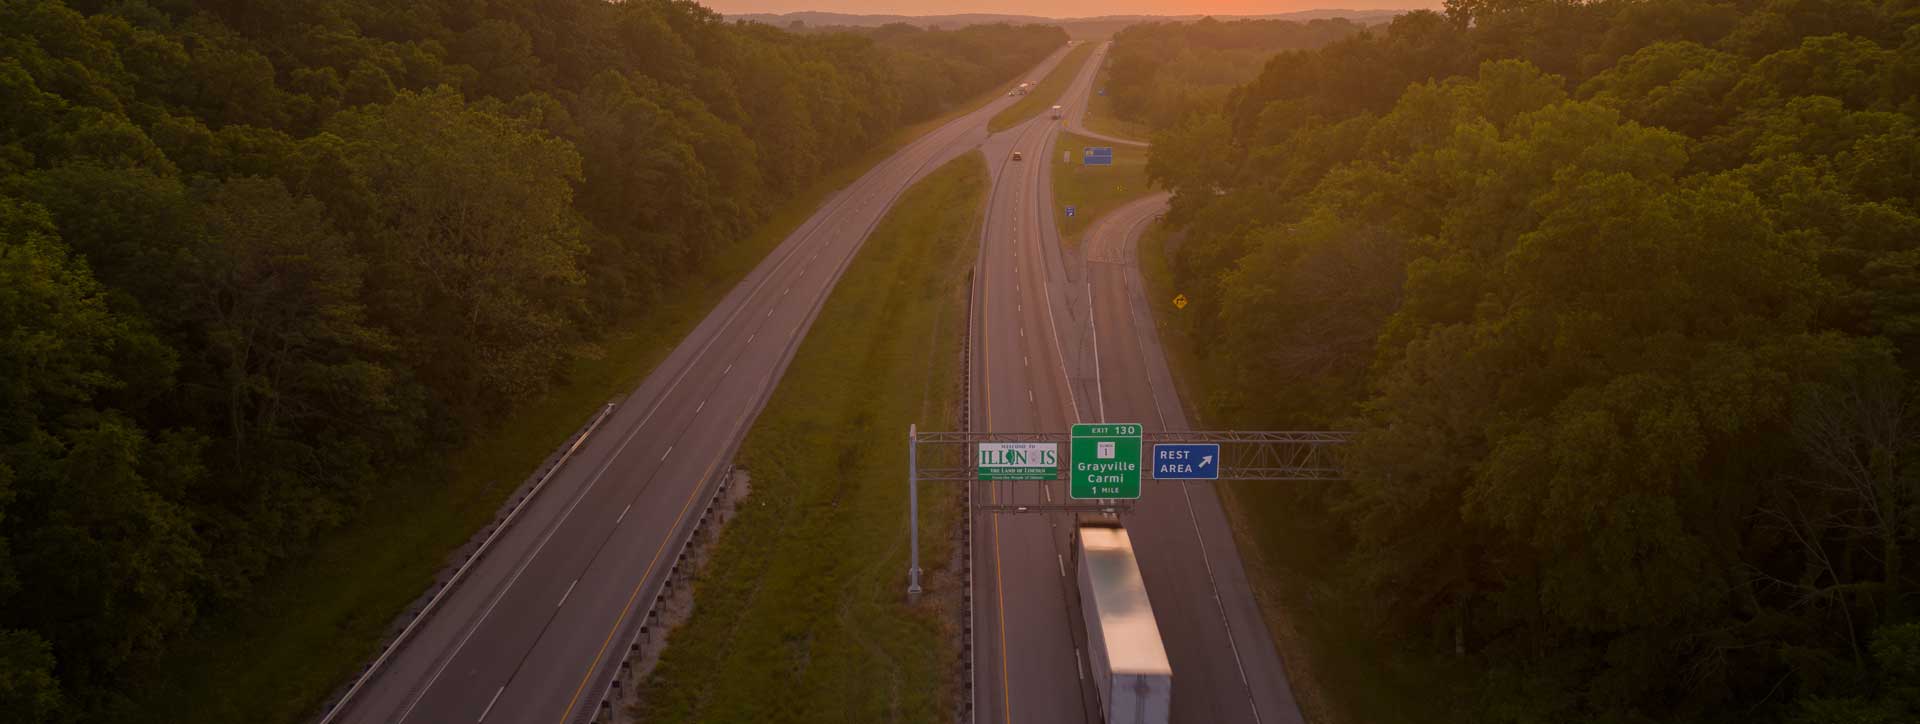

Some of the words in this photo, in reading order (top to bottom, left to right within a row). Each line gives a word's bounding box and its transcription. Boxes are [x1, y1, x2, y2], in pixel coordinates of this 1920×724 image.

[1115, 426, 1135, 435] 130
[981, 449, 1056, 465] ILLINIS
[1160, 450, 1191, 460] REST
[1077, 461, 1136, 473] Grayville
[1160, 464, 1193, 473] AREA
[1087, 473, 1125, 483] Carmi
[1091, 486, 1097, 495] 1
